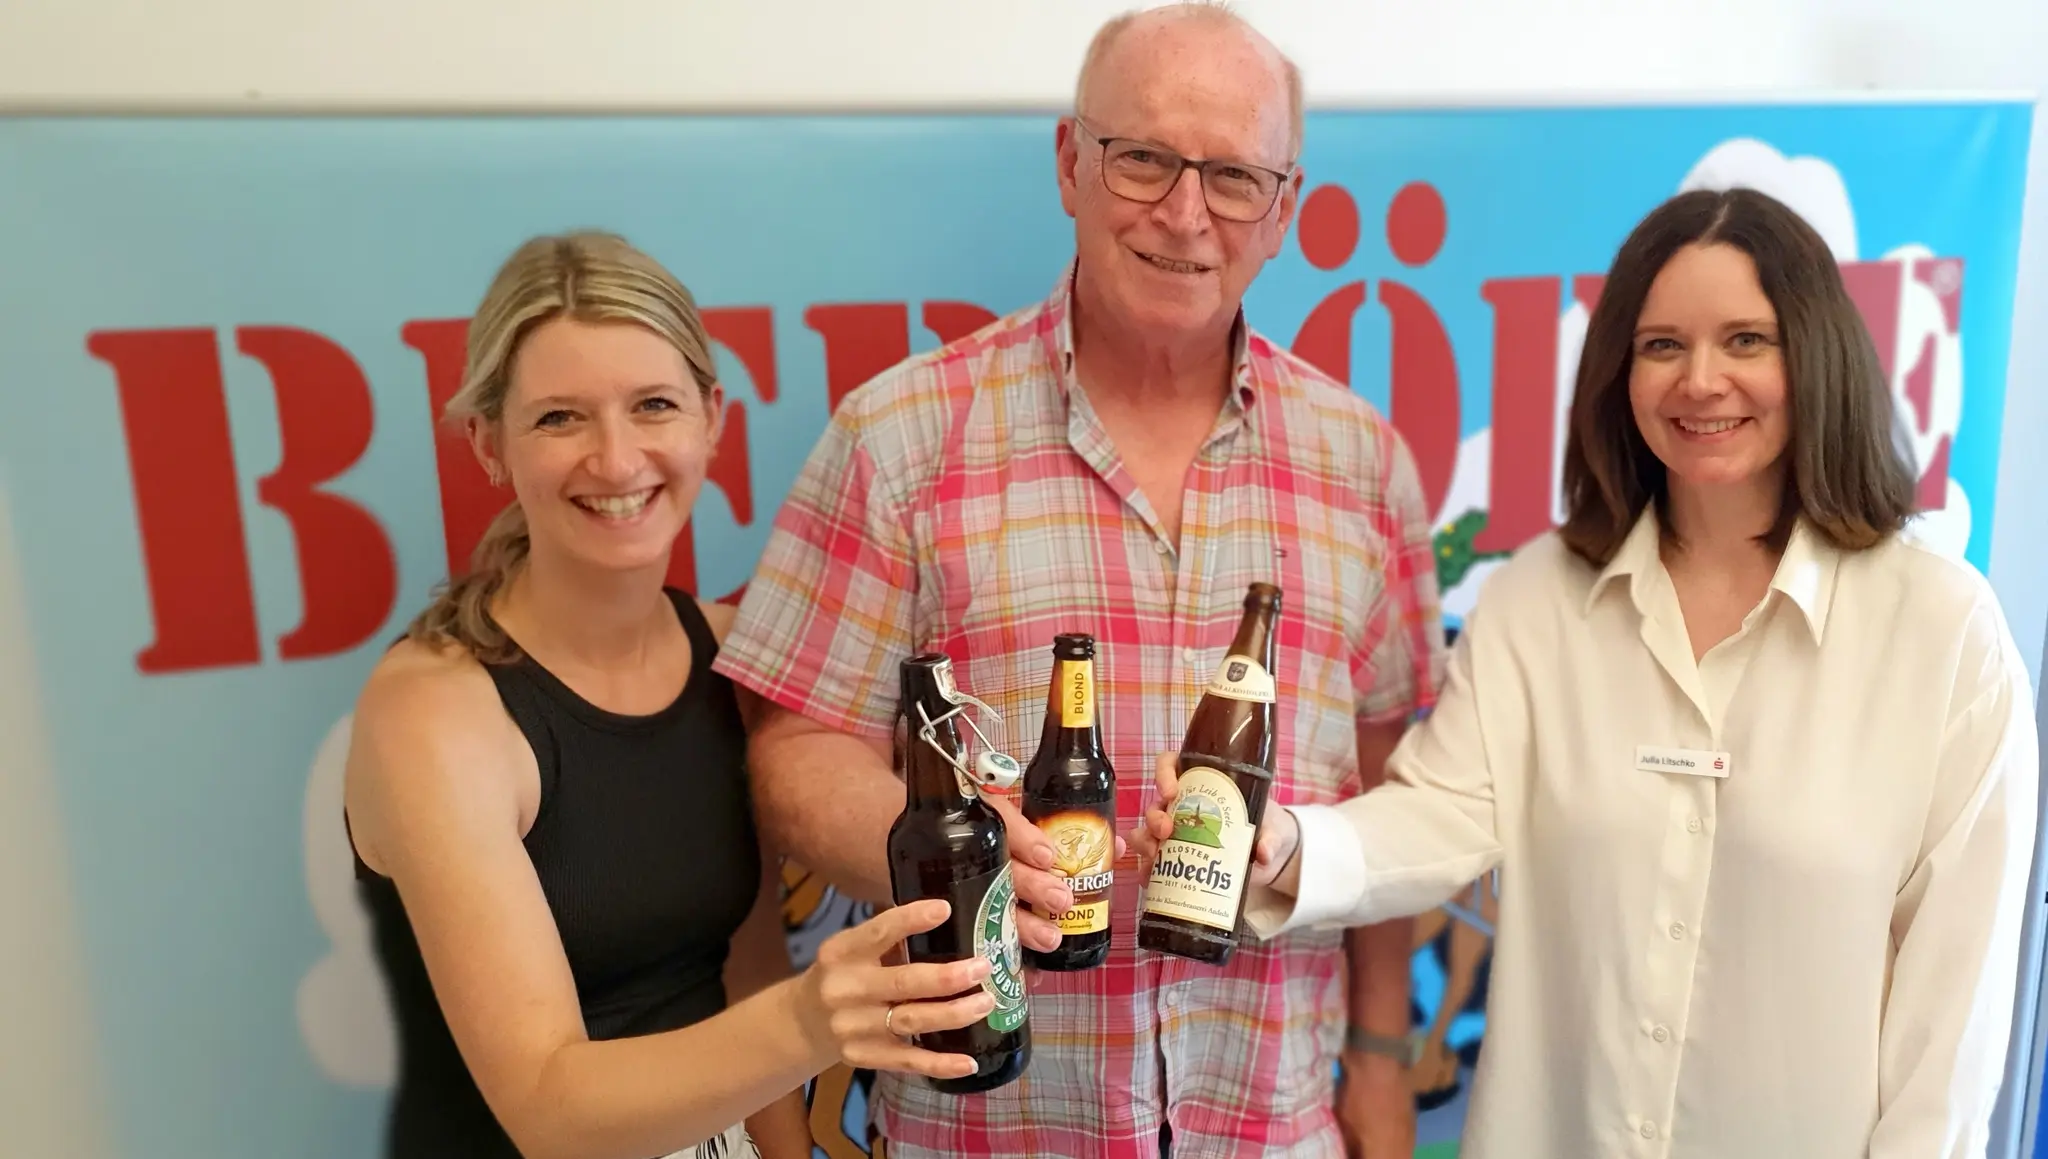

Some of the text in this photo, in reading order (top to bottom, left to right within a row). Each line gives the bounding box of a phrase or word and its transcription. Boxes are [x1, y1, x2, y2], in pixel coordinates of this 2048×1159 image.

[1074, 672, 1084, 714] BLOND
[1641, 756, 1696, 768] Julia Litschko
[1198, 784, 1219, 797] Leib
[1222, 806, 1234, 828] Seele
[1167, 845, 1210, 861] KLOSTER
[1152, 849, 1232, 890] Andechs
[1063, 870, 1114, 891] BERGEN
[1164, 880, 1178, 888] SEIT
[1049, 908, 1095, 921] BLOND
